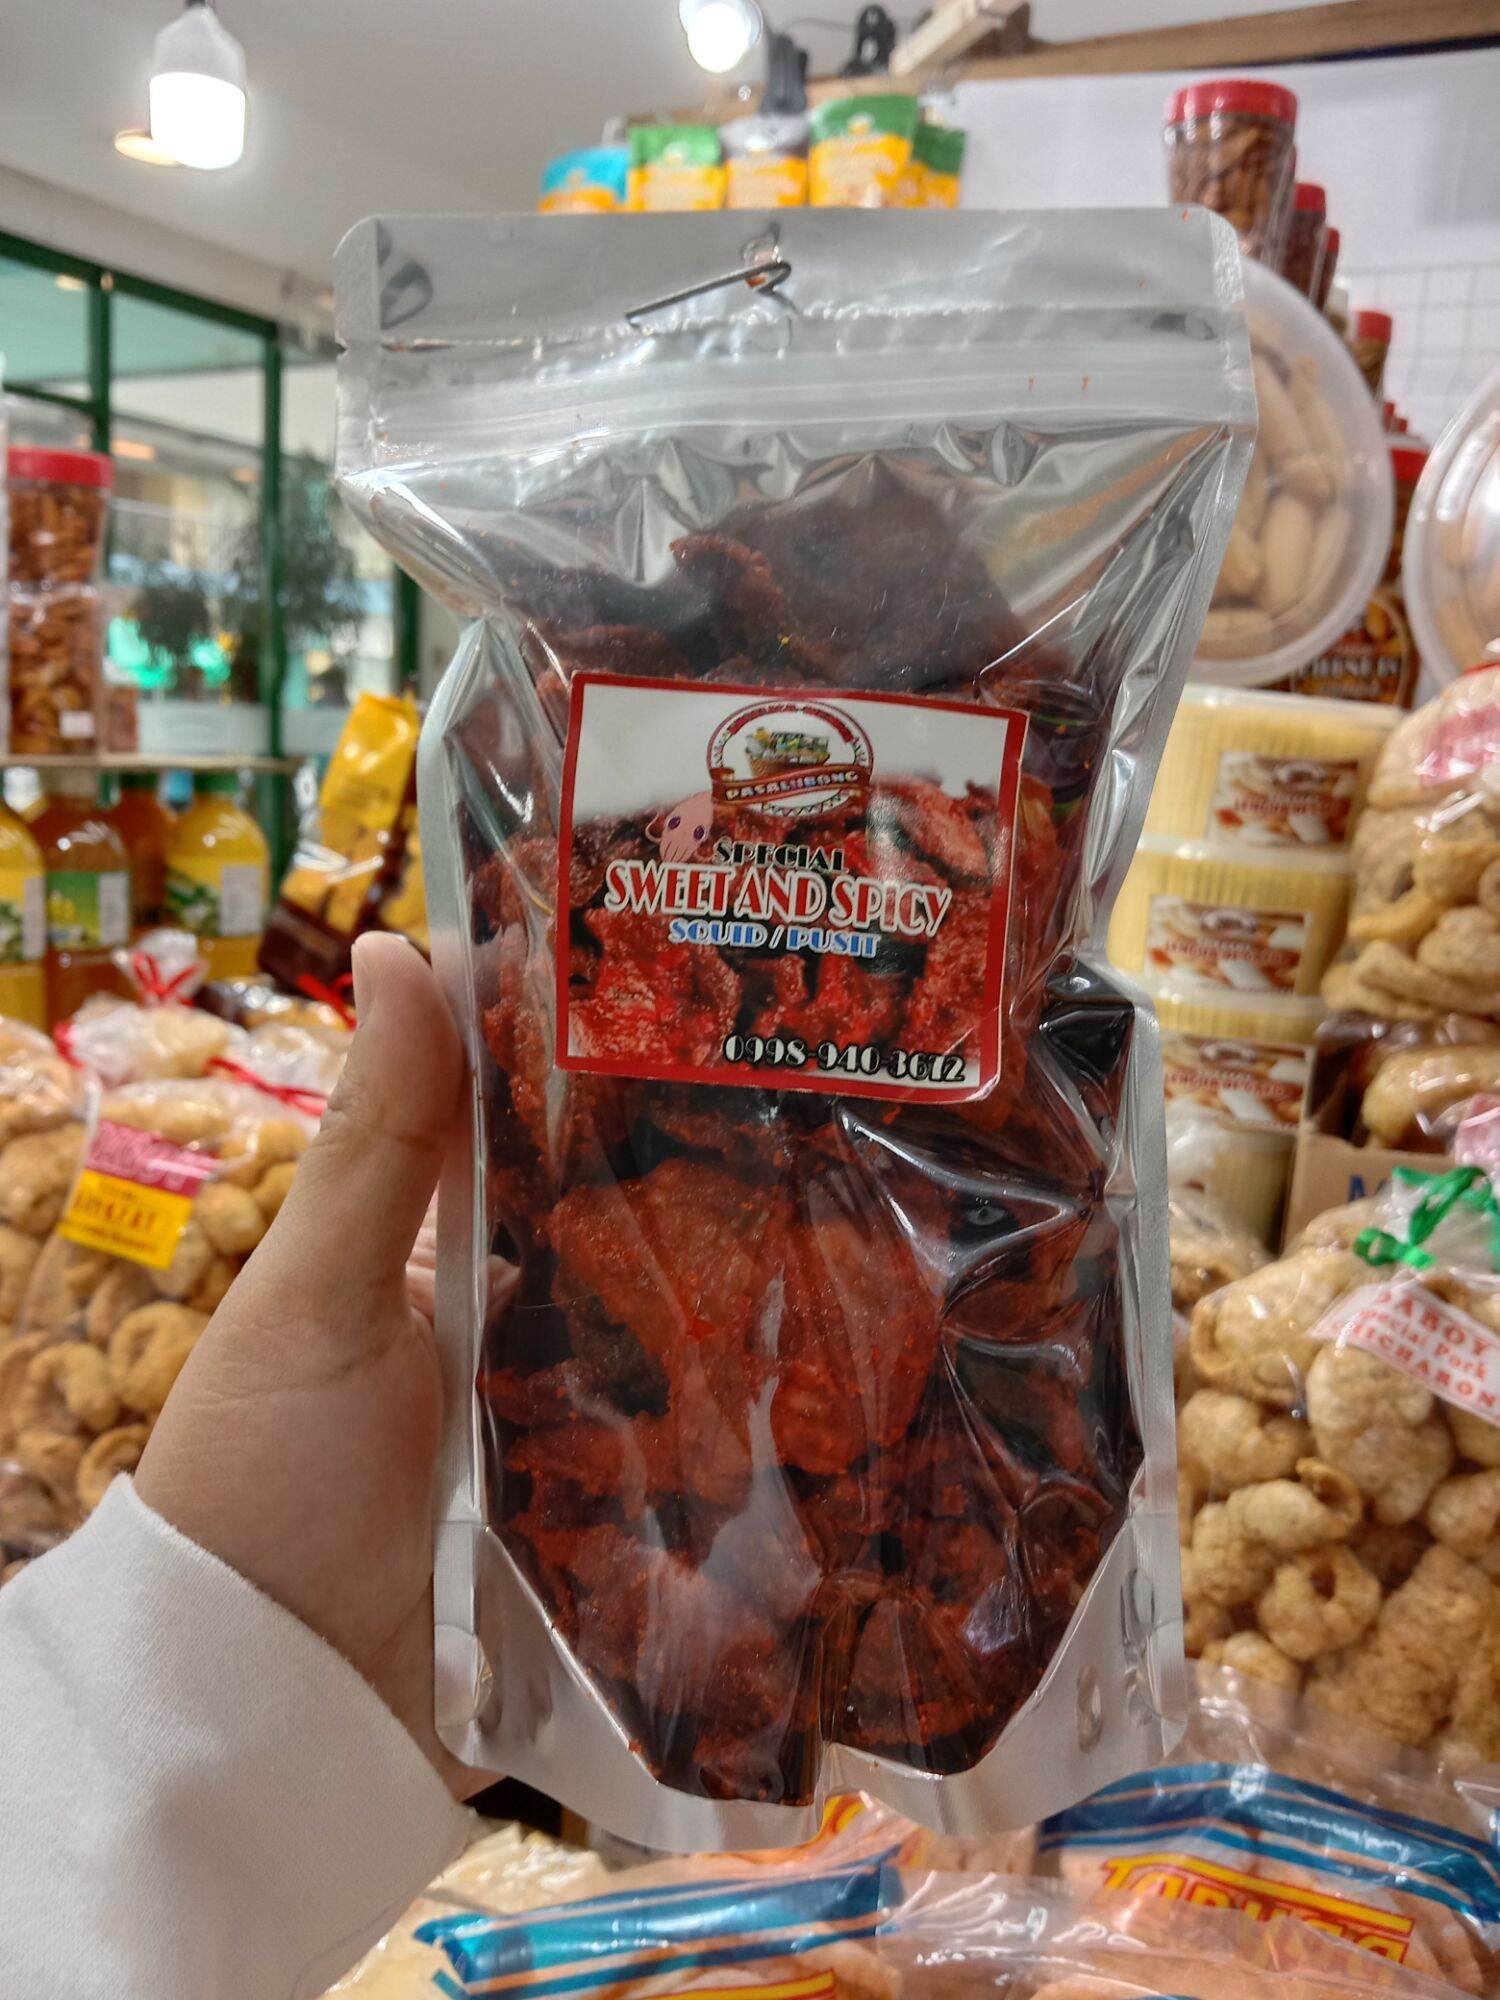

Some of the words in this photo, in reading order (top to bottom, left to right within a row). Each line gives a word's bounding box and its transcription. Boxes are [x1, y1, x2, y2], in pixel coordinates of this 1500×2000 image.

[725, 771, 858, 800] PASALUBONG
[712, 838, 850, 874] SPECIAL
[604, 860, 736, 915] SWEET
[735, 866, 828, 923] AND
[828, 874, 952, 937] SPICY
[668, 919, 768, 948] SQUID
[770, 926, 784, 948] /
[786, 926, 881, 959] PUSIT
